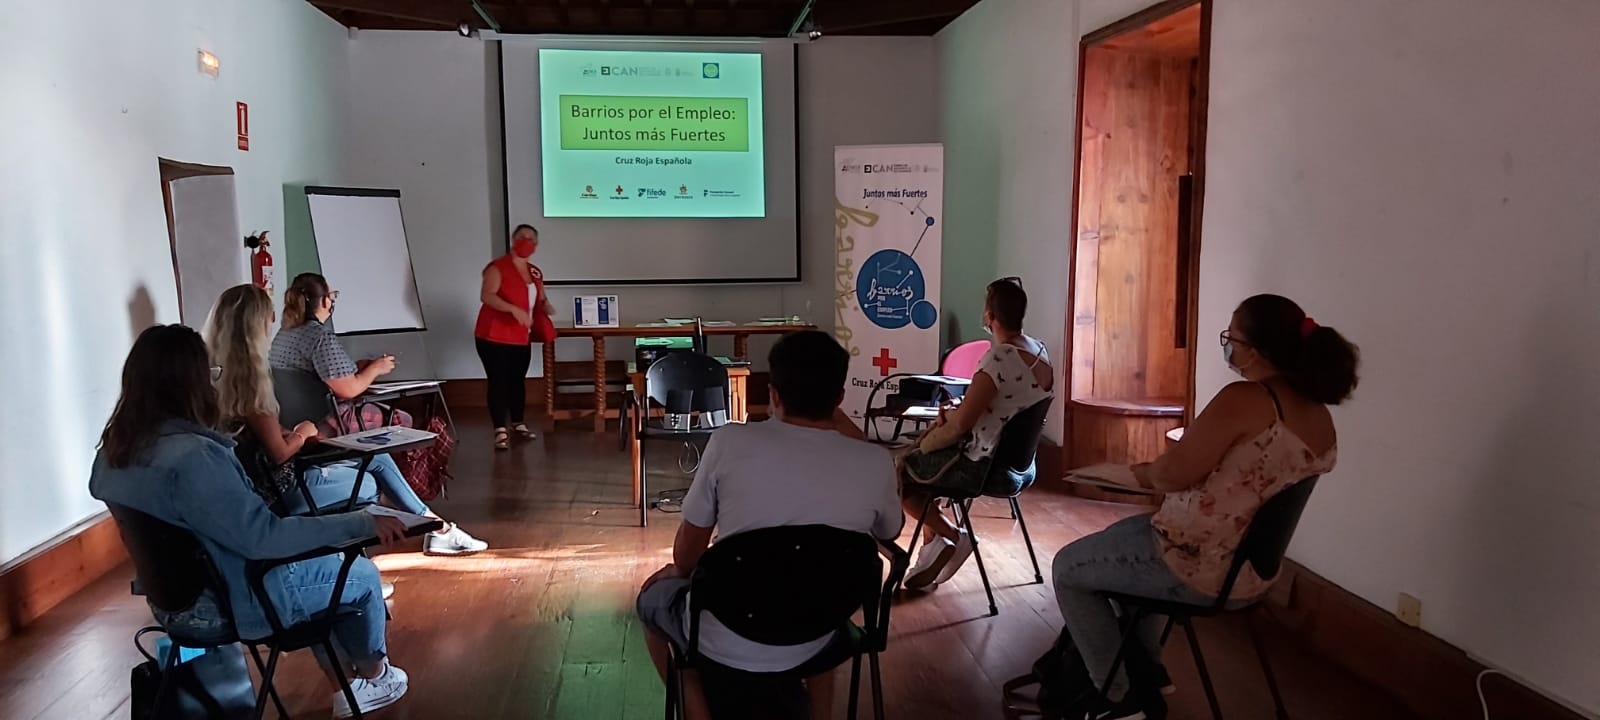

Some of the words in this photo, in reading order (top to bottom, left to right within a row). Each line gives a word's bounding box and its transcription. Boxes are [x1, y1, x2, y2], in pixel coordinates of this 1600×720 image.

[571, 105, 624, 118] Barrios
[629, 108, 654, 121] por
[659, 106, 671, 119] el
[676, 107, 736, 122] Empleo:
[582, 127, 631, 141] Juntos
[635, 127, 666, 141] más
[670, 128, 726, 142] Fuertes
[615, 157, 633, 165] Cruz
[635, 157, 653, 166] Roja
[655, 157, 693, 166] Española
[863, 188, 886, 199] Juntos
[886, 188, 901, 198] más
[902, 189, 928, 198] Fuertes
[852, 377, 868, 388] Cruz
[869, 379, 885, 390] Roa
